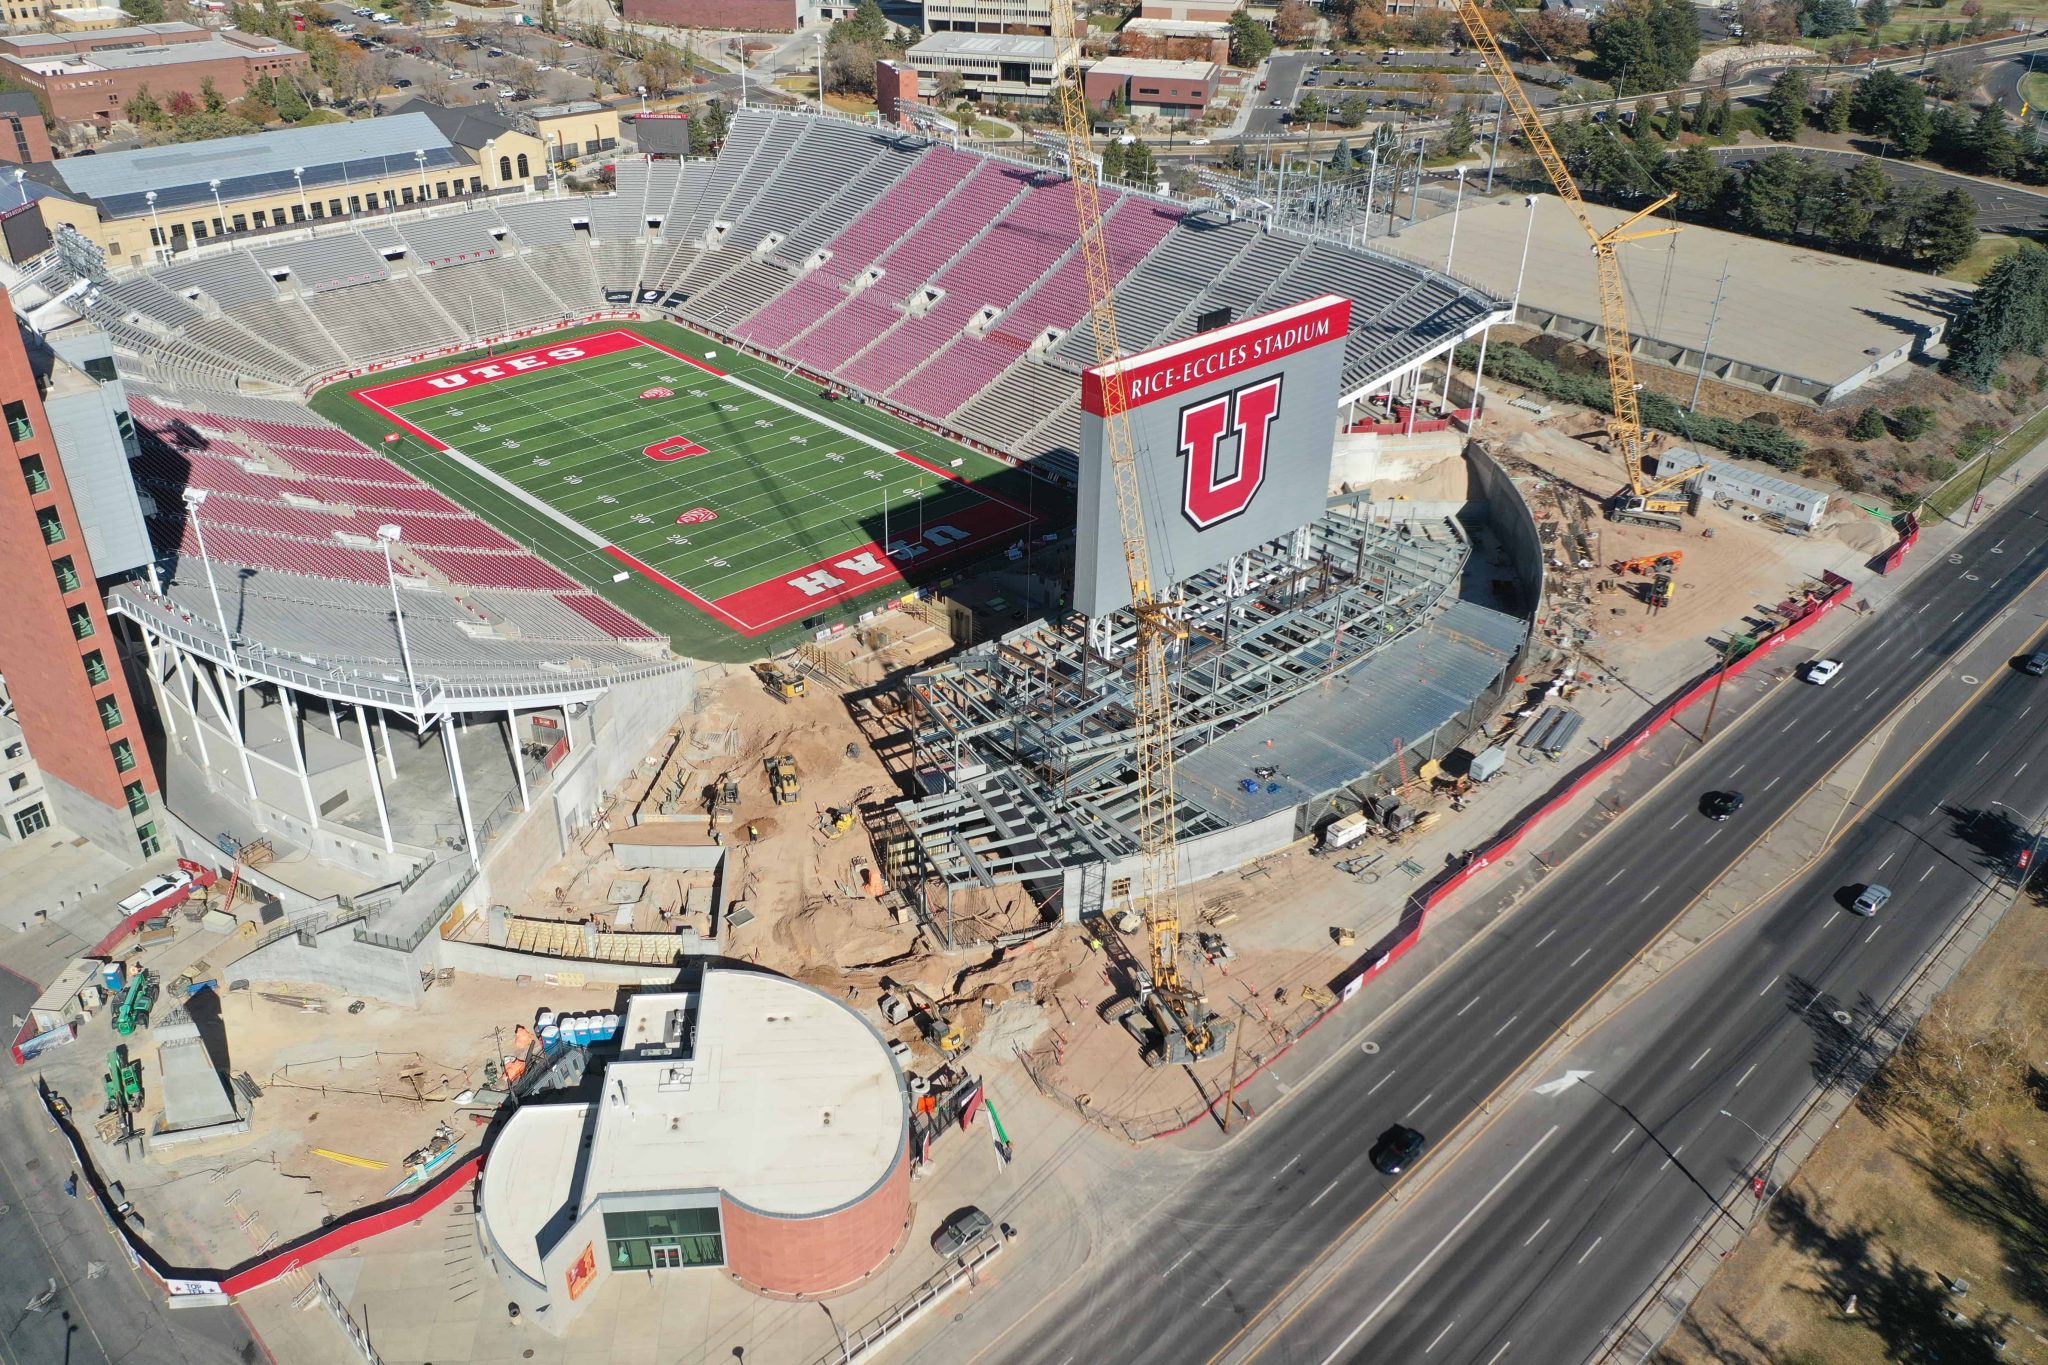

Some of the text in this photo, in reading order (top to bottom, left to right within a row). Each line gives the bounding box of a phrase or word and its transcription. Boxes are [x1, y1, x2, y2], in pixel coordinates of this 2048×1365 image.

[427, 347, 585, 389] UTES
[1131, 318, 1330, 400] RICE-ECCLES STADIUM
[642, 435, 711, 462] U
[1176, 372, 1284, 533] U
[563, 474, 583, 485] 50
[595, 492, 616, 504] 40
[630, 513, 651, 525] 30
[666, 533, 688, 545] 20
[704, 555, 728, 567] 10
[787, 525, 971, 597] UTAH
